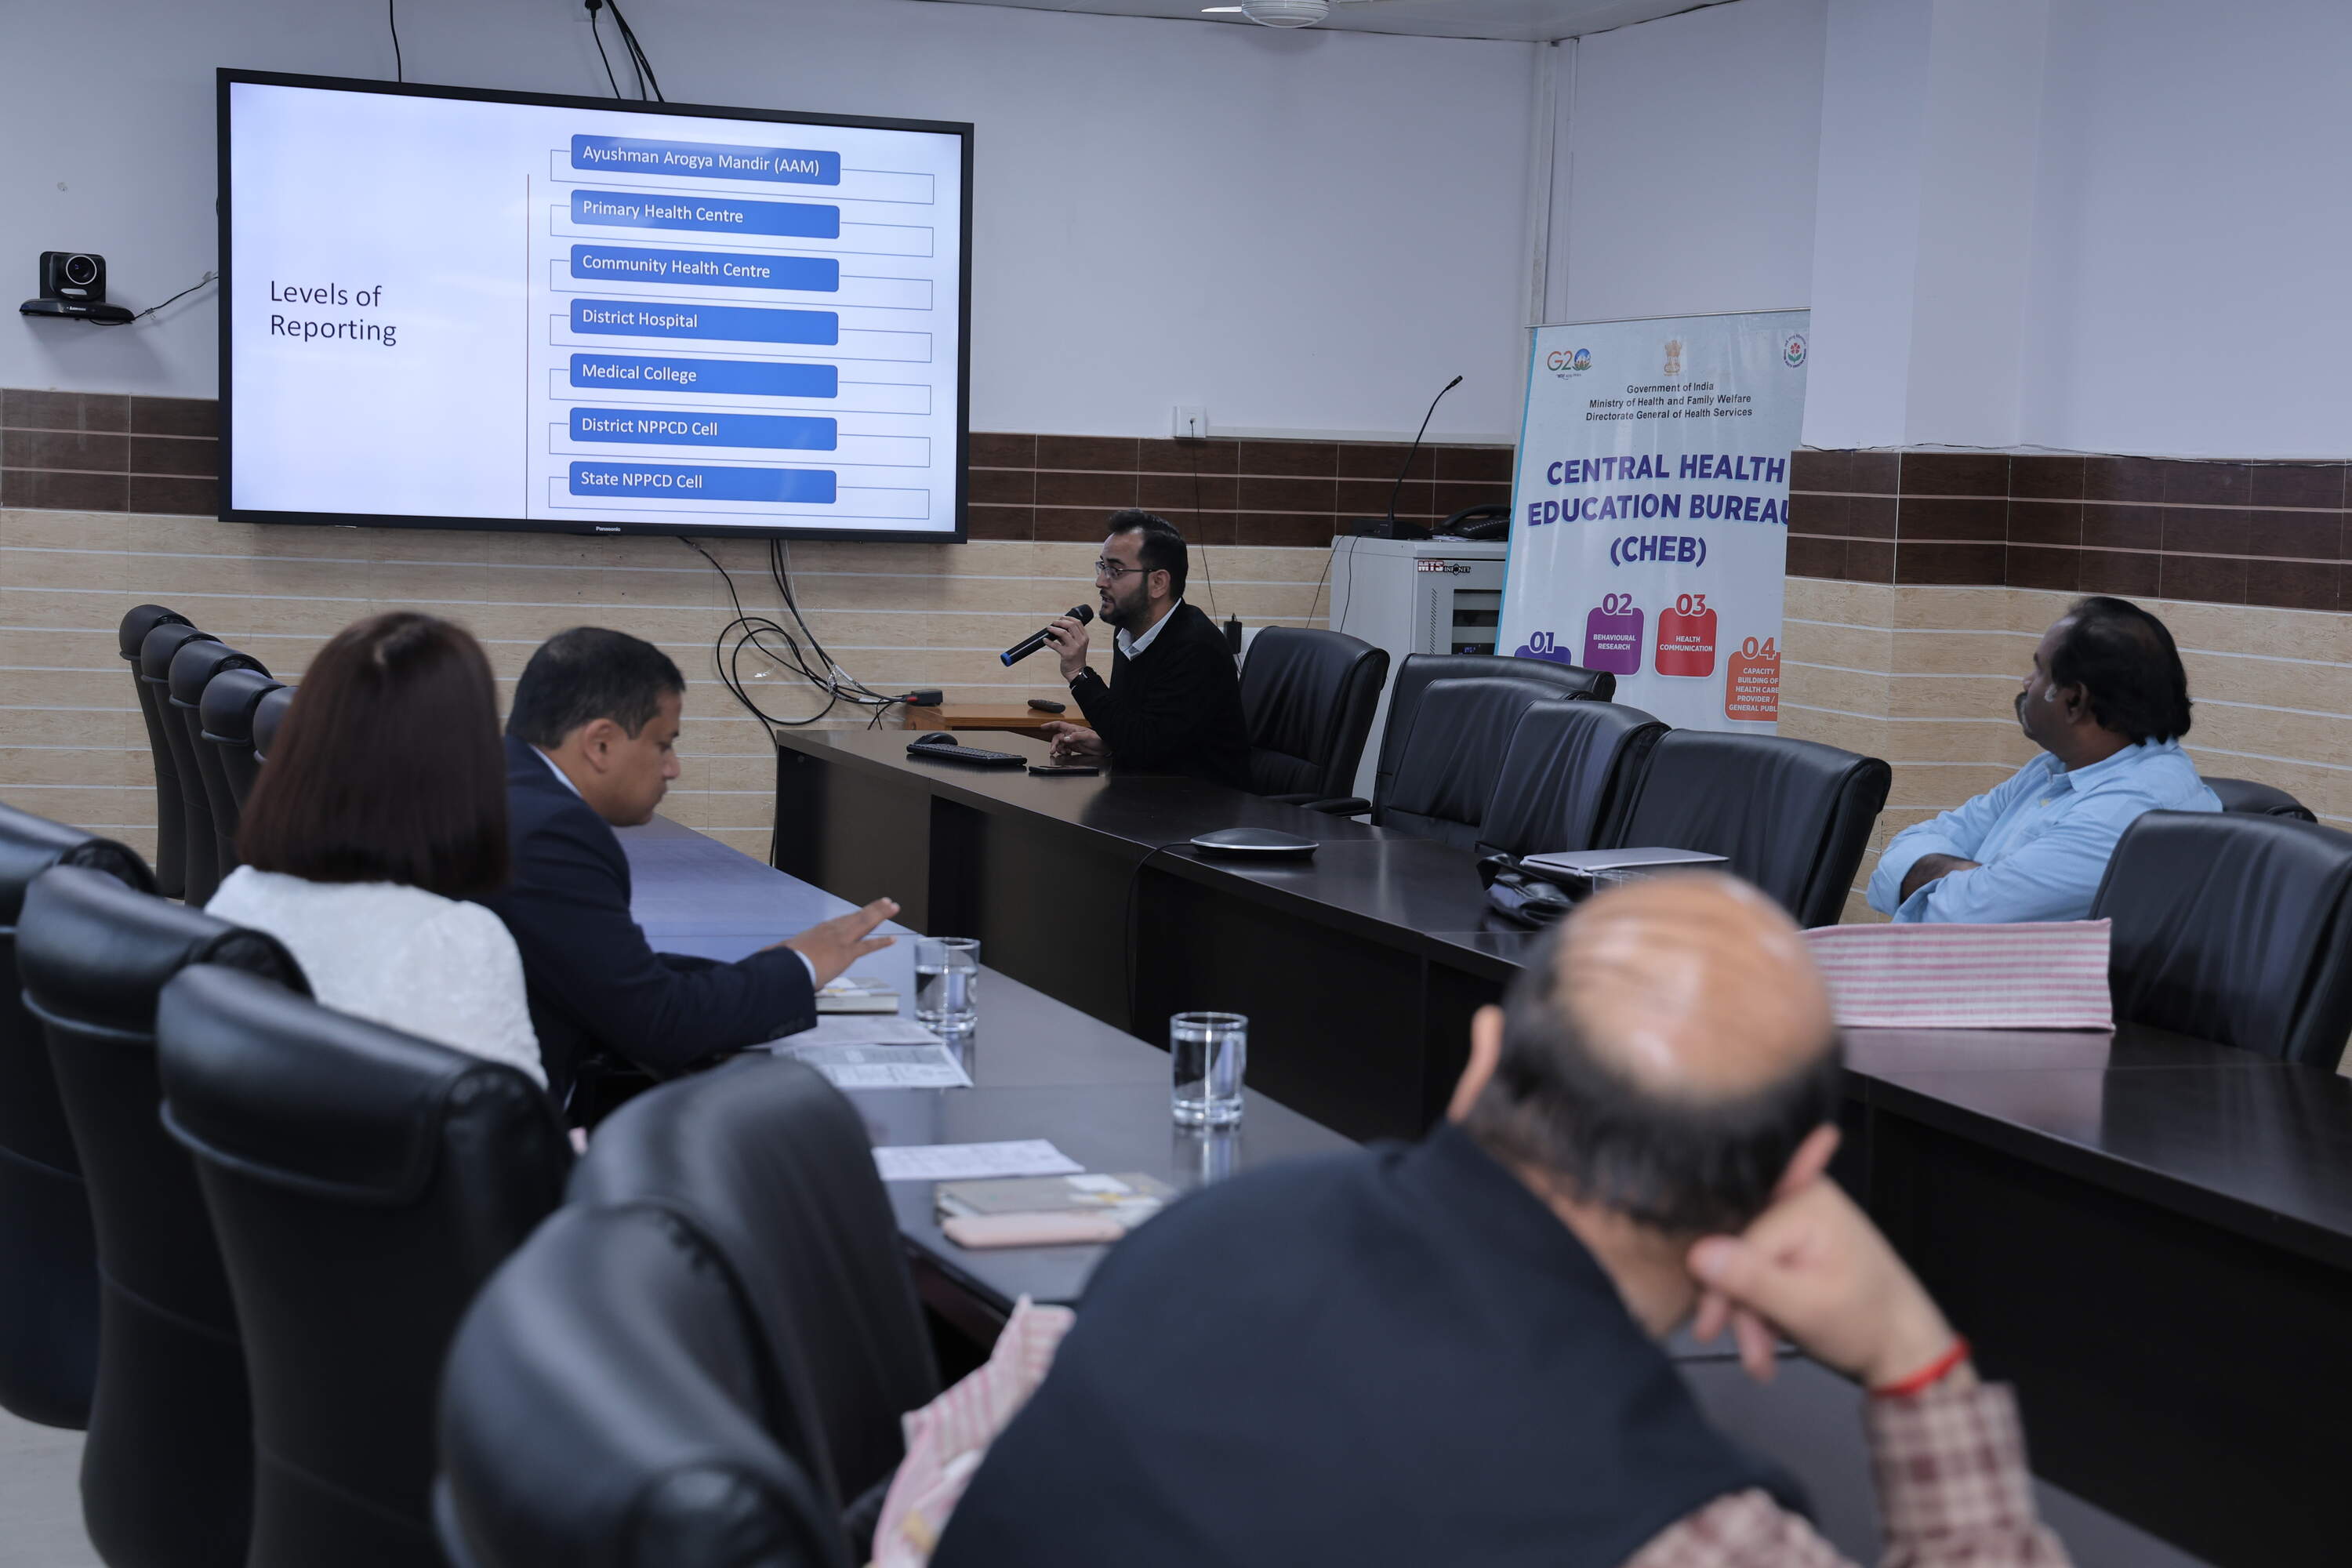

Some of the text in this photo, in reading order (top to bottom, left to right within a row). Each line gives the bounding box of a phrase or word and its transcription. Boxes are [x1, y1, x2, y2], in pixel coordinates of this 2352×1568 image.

[583, 146, 820, 176] Ayushman Arogya Mandir (AAM)
[583, 201, 743, 223] Primary Health Centre
[583, 255, 771, 278] Community Health Centre
[271, 281, 382, 307] Levels of
[583, 309, 698, 329] District Hospital
[271, 314, 397, 347] Reporting
[1547, 348, 1592, 371] G20
[583, 363, 697, 384] Medical College
[1627, 382, 1714, 394] Government of India
[1589, 394, 1751, 408] Ministry of Health and Family Welfare
[1586, 408, 1752, 421] Directorate General of Health Services
[582, 418, 718, 436] District NPPCD Cell
[581, 472, 702, 488] State NPPCD Cell
[1547, 455, 1785, 485] CENTRAL HEALTH
[1528, 493, 1681, 526] EDUCATION
[1610, 535, 1706, 567] (CHEB)
[1417, 560, 1443, 572] MTS
[1602, 593, 1632, 615] 02
[1676, 593, 1706, 616] 03
[1530, 631, 1555, 652] 01
[1593, 633, 1636, 642] BEHAVIOURAL
[1660, 644, 1713, 652] COMMUNICATION
[1675, 635, 1700, 644] HEALTH
[1742, 637, 1775, 659] 04
